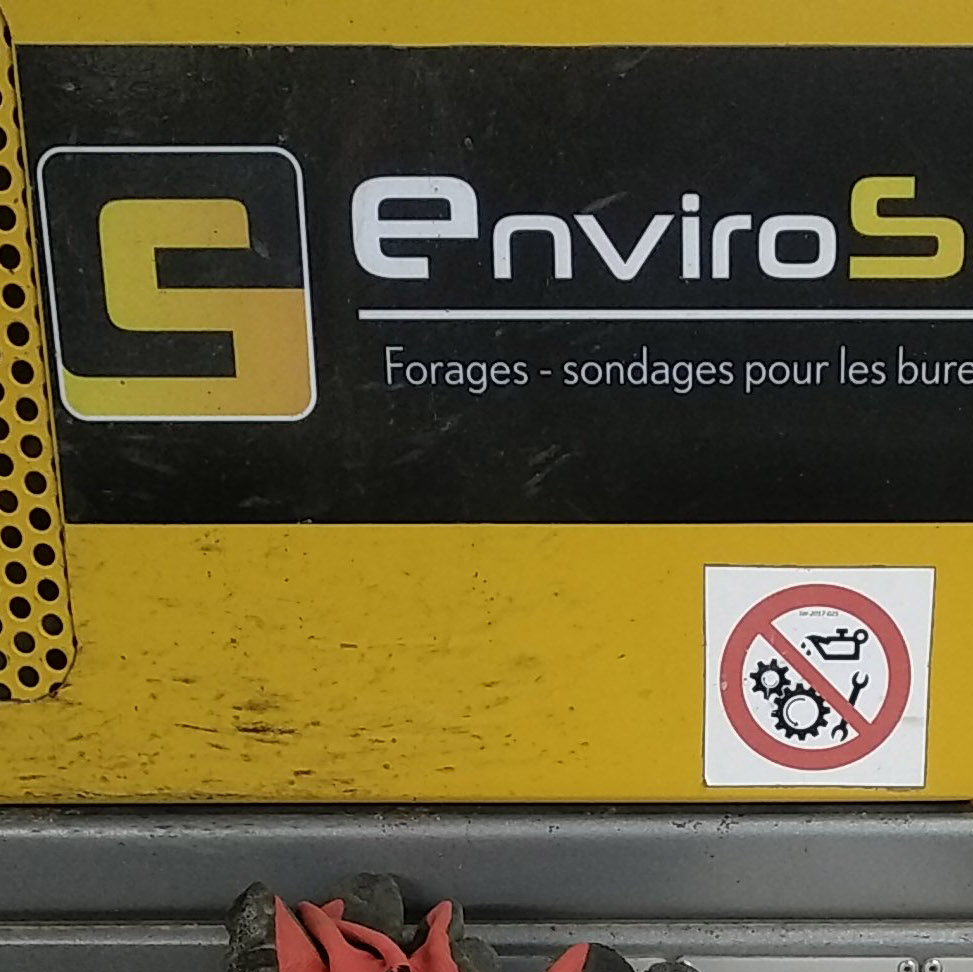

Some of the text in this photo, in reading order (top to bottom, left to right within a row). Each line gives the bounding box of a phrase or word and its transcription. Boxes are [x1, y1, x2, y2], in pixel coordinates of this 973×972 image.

[384, 345, 529, 394] Forages
[563, 345, 735, 394] sondages
[745, 360, 830, 394] pour
[839, 345, 887, 385] les
